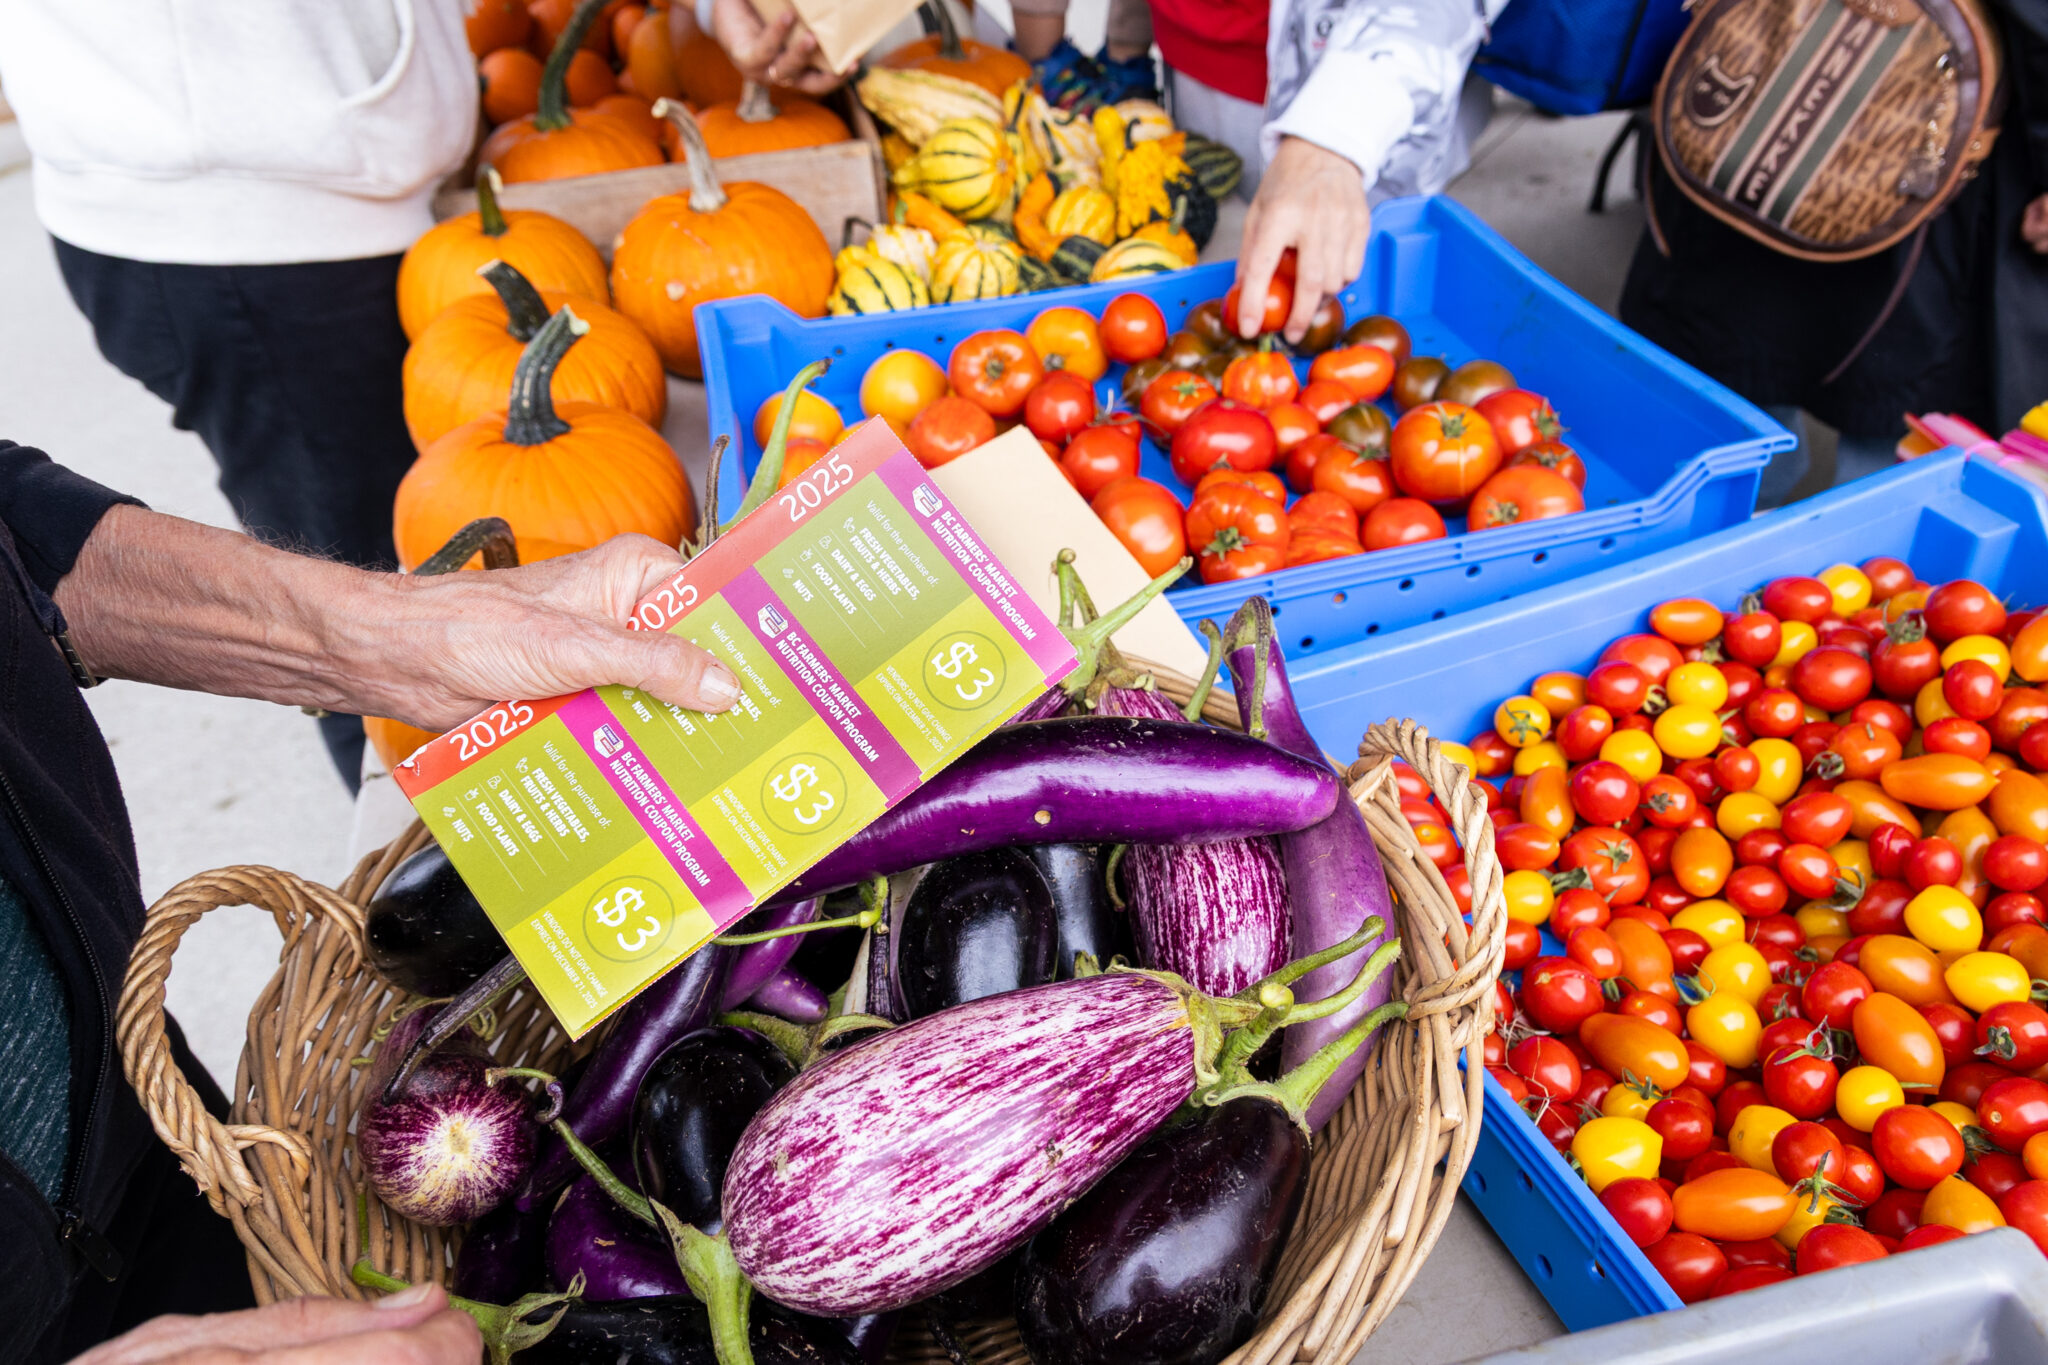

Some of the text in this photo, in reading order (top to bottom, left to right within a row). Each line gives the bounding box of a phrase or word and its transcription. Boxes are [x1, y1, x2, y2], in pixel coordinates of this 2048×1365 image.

[778, 453, 854, 522] 2025
[849, 534, 902, 595] FRUITS & HERBS
[859, 527, 920, 600] FRESH VEGETABLES,
[866, 499, 939, 585] Valid for the purchase of:
[940, 510, 956, 526] BC
[984, 562, 1018, 598] MARKET
[792, 578, 814, 602] NUTS
[811, 562, 857, 614] FOOD PLANTS
[830, 548, 877, 601] DAIRY & EGGS
[931, 518, 1037, 640] NUTRITION COUPON PROGRAM
[710, 621, 730, 643] Valid
[724, 639, 737, 653] for
[733, 651, 747, 666] the
[741, 664, 772, 697] purchase
[768, 696, 782, 708] of:
[786, 631, 802, 646] BC
[828, 682, 862, 718] MARKET
[875, 672, 897, 695] EXPIRES
[930, 640, 995, 701] $3
[631, 700, 653, 722] NUTS
[669, 705, 697, 735] PLANTS
[736, 691, 762, 722] TABLES,
[775, 639, 879, 762] NUTRITION COUPON PROGRAM
[886, 665, 952, 743] VENDORS DO NOT GIVE CHANGE
[892, 692, 903, 703] ON
[897, 698, 926, 730] DECEMBER
[449, 700, 534, 761] 2025
[928, 736, 944, 752] 2025
[498, 788, 543, 843] DAIRY & EGGS
[520, 775, 570, 837] FRUITS & HERBS
[531, 767, 590, 843] FRESH VEGETABLES,
[543, 740, 612, 829] Valid for the purchase of:
[620, 751, 637, 767] BC
[661, 804, 695, 841] MARKET
[769, 763, 835, 825] $3
[451, 818, 474, 842] NUTS
[475, 802, 520, 856] FOOD PLANTS
[609, 759, 650, 807] NUTRITION
[644, 804, 678, 843] COUPON
[671, 839, 711, 887] PROGRAM
[711, 794, 732, 818] EXPIRES
[728, 815, 738, 826] ON
[734, 823, 761, 854] DECEMBER
[763, 860, 779, 878] 2025
[722, 786, 788, 867] VENDORS DO NOT GIVE CHANGE
[592, 886, 662, 952] $3
[530, 918, 552, 944] EXPIRES
[546, 941, 558, 953] ON
[553, 950, 580, 983] DECEMBER
[581, 990, 598, 1009] 2025
[542, 911, 608, 998] VENDORS DO NOT GIVE CHANGE
